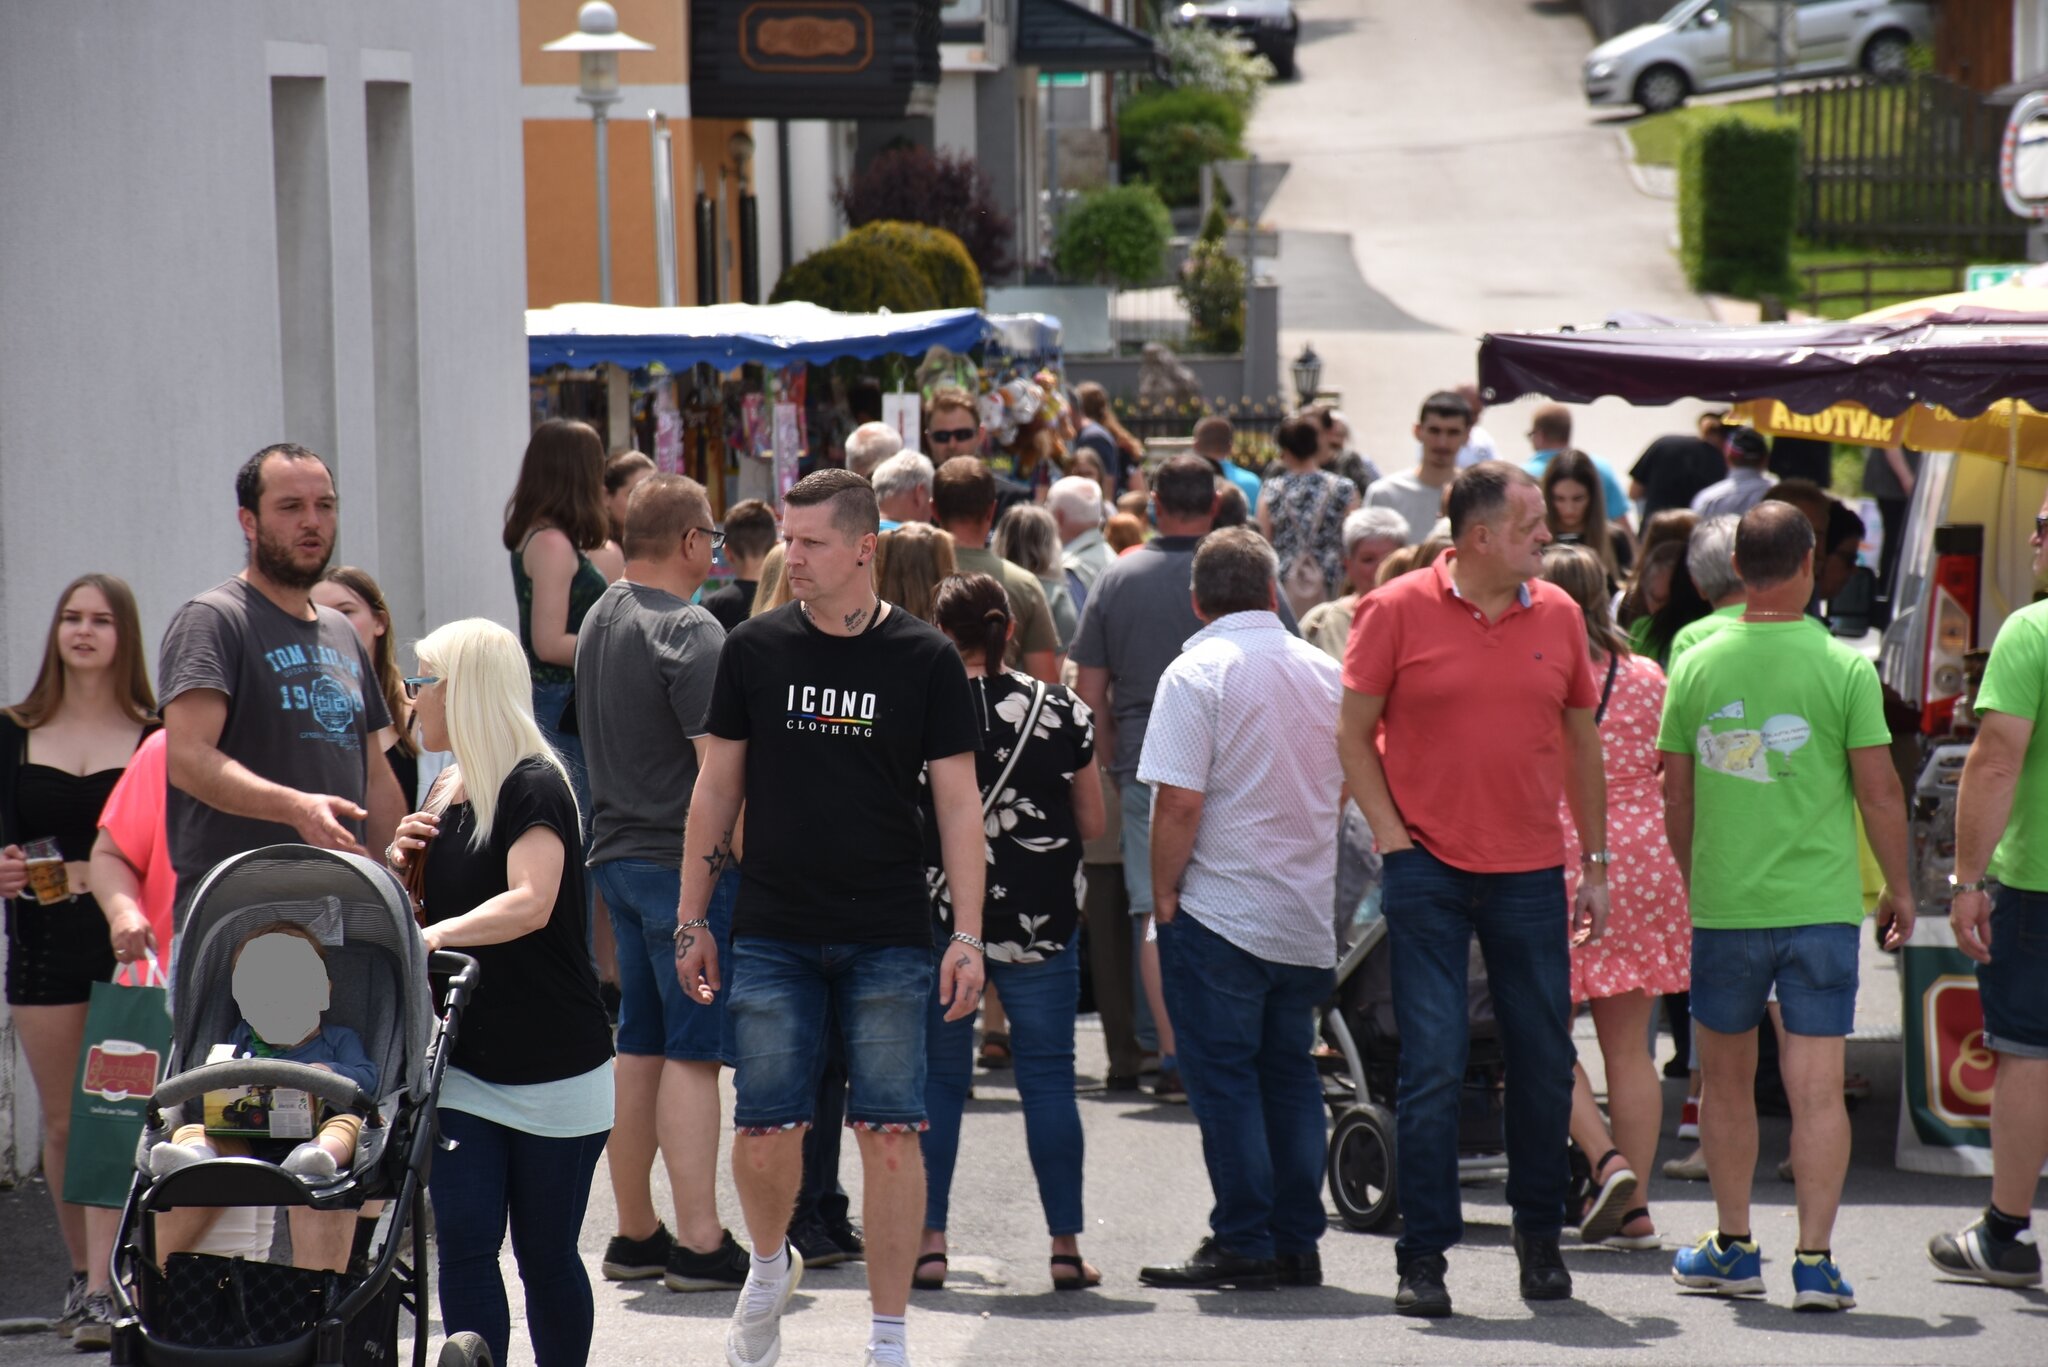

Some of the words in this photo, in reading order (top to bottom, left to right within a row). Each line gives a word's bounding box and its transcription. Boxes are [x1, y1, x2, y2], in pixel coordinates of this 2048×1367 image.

[265, 644, 307, 672] TOM
[787, 684, 876, 719] ICONO
[786, 719, 873, 738] CLOTHING
